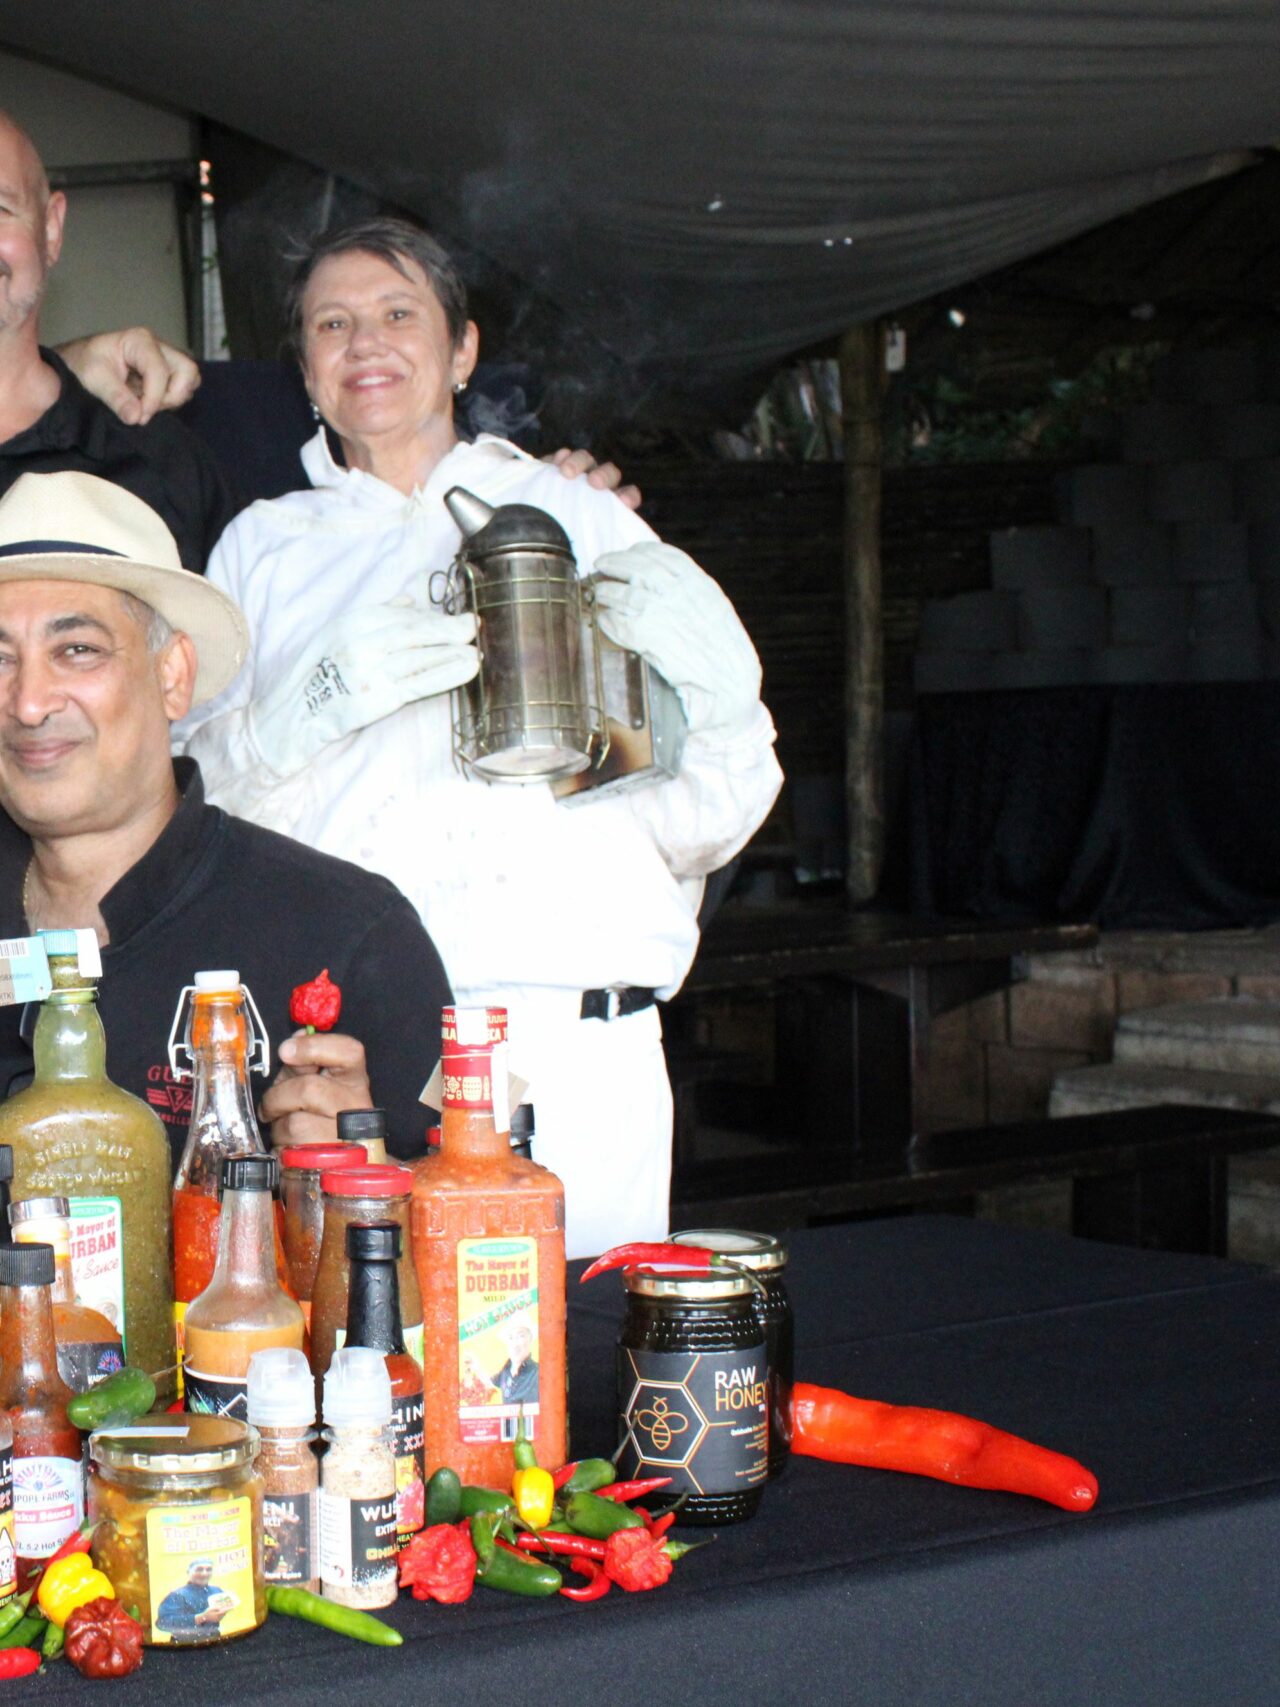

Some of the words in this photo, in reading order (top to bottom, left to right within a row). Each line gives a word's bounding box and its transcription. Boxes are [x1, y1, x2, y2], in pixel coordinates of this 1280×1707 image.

[76, 1222, 105, 1238] Mayor
[107, 1215, 116, 1229] of
[83, 1258, 120, 1280] Sauce
[465, 1272, 530, 1293] DURBAN
[714, 1365, 757, 1390] RAW
[715, 1380, 768, 1412] HONEY
[163, 1525, 191, 1539] The
